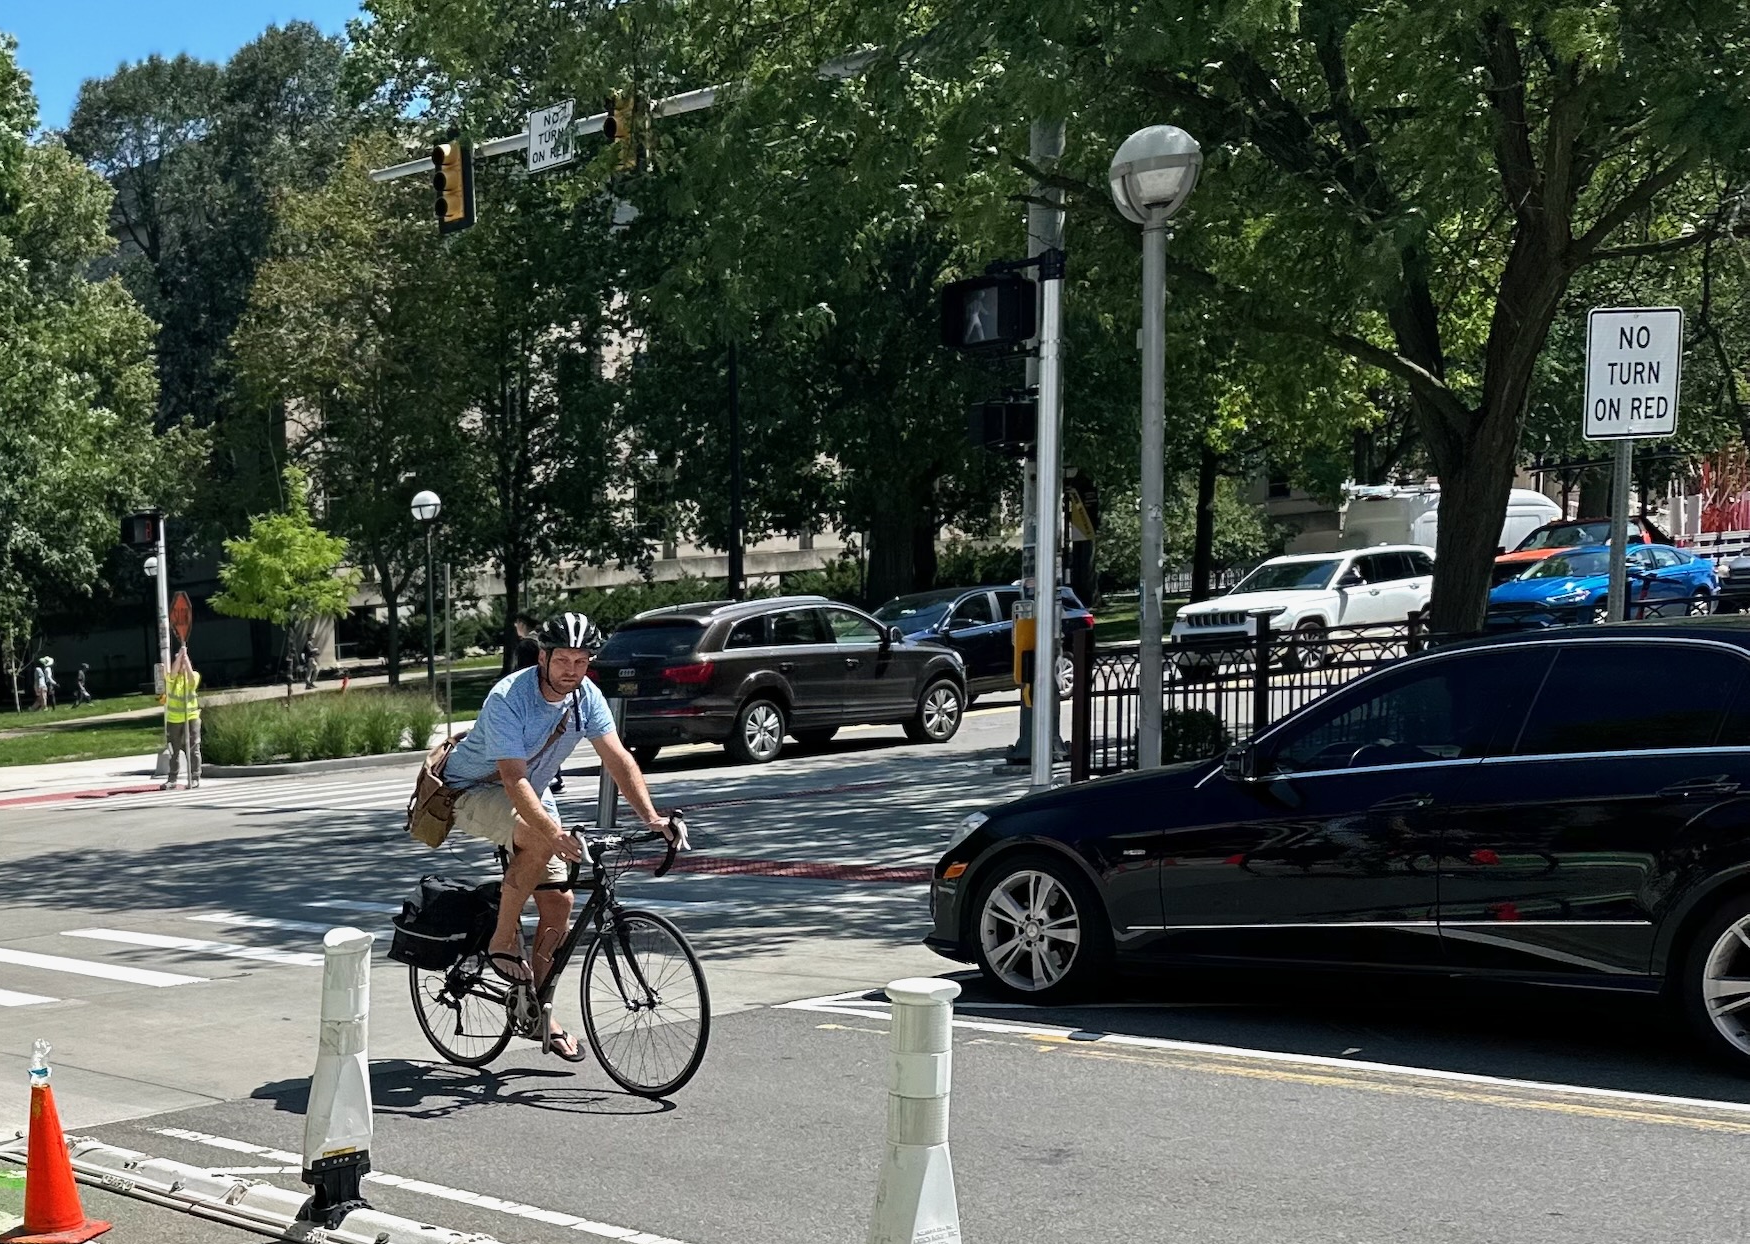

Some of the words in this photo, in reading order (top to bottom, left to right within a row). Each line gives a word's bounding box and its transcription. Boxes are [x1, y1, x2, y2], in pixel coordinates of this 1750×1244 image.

[543, 112, 560, 127] NO
[532, 149, 546, 164] ON
[1619, 325, 1651, 350] NO
[1607, 360, 1661, 386] TURN
[1594, 397, 1621, 422] ON
[1630, 395, 1669, 420] RED
